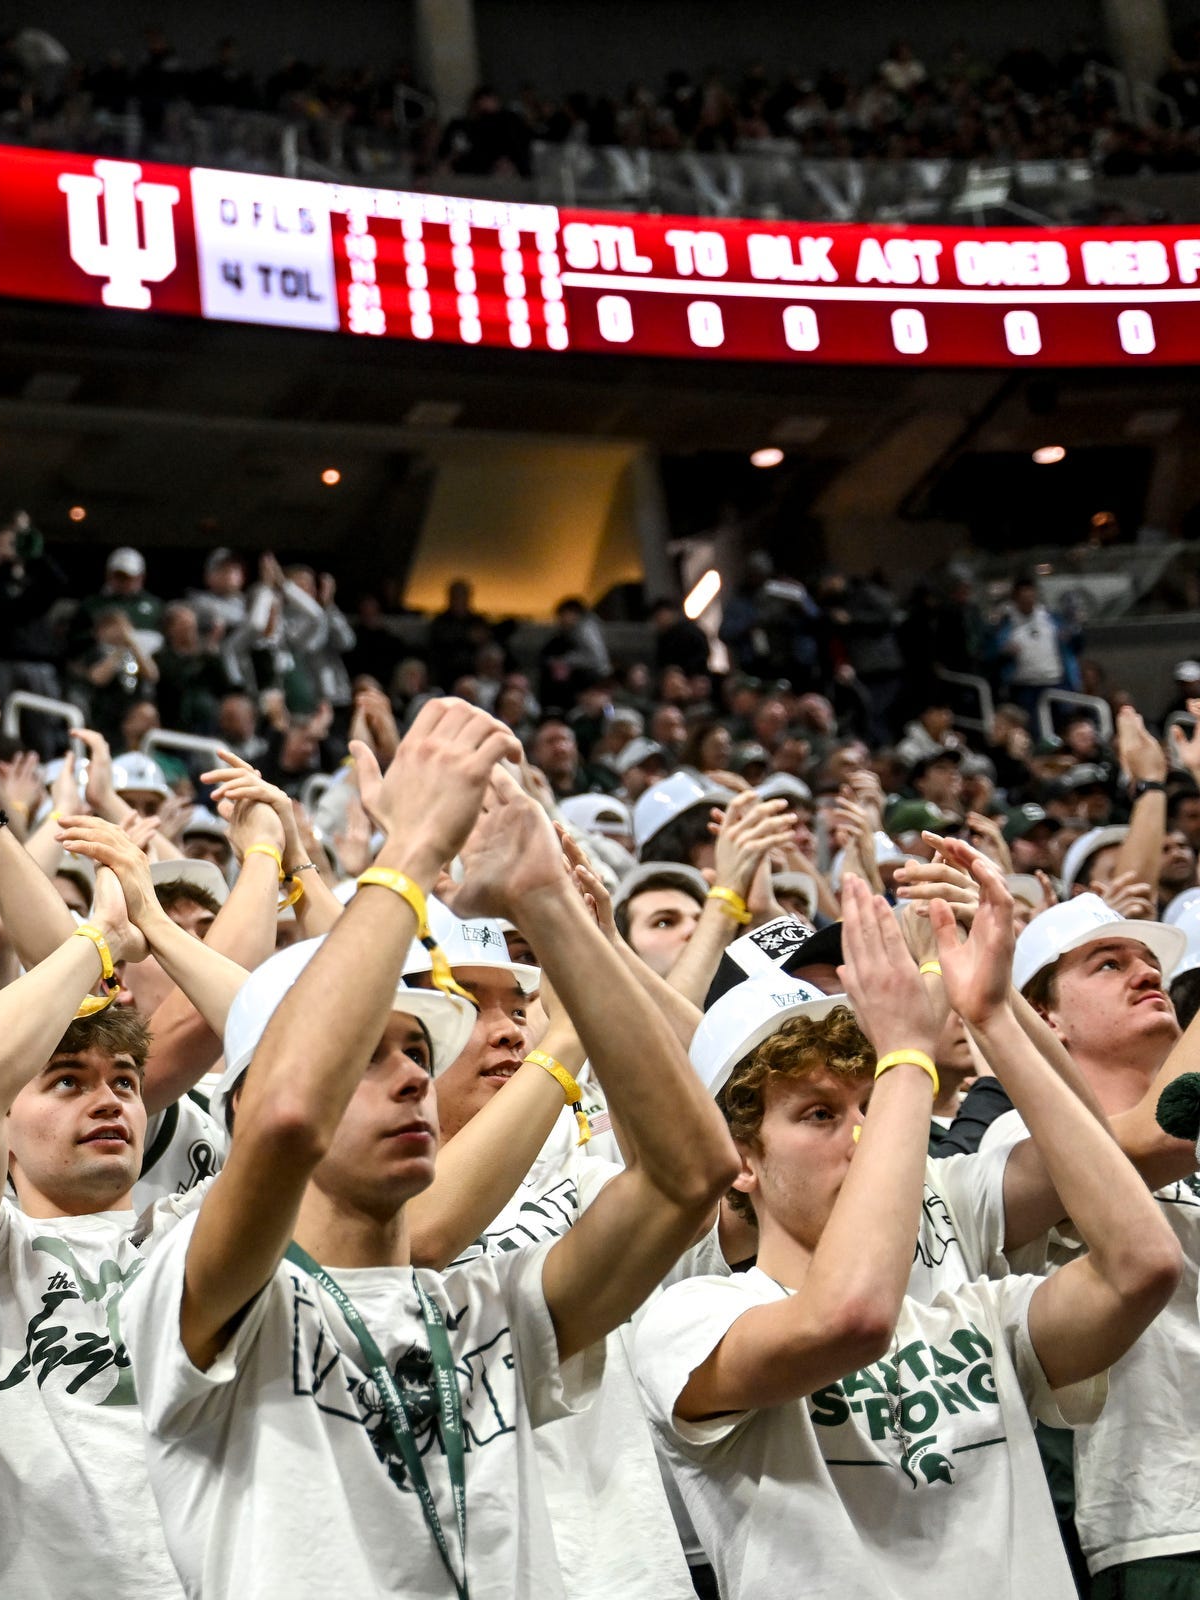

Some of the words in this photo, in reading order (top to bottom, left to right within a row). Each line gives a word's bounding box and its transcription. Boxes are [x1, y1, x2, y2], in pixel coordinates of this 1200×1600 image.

[563, 223, 652, 272] STL
[665, 230, 728, 278] TO
[747, 234, 838, 283] BLK
[855, 238, 943, 285] AST
[1081, 240, 1170, 285] REB
[220, 261, 243, 292] 4
[257, 264, 323, 303] TOL
[596, 296, 634, 342] 0
[687, 301, 725, 347] 0
[783, 306, 820, 351] 0
[890, 308, 928, 354] 0
[1004, 310, 1042, 355] 0
[1117, 309, 1156, 354] 0
[48, 1271, 78, 1290] the
[314, 1272, 348, 1305] AXIOS
[441, 1388, 456, 1433] AXIOS
[810, 1363, 1000, 1441] SRONG
